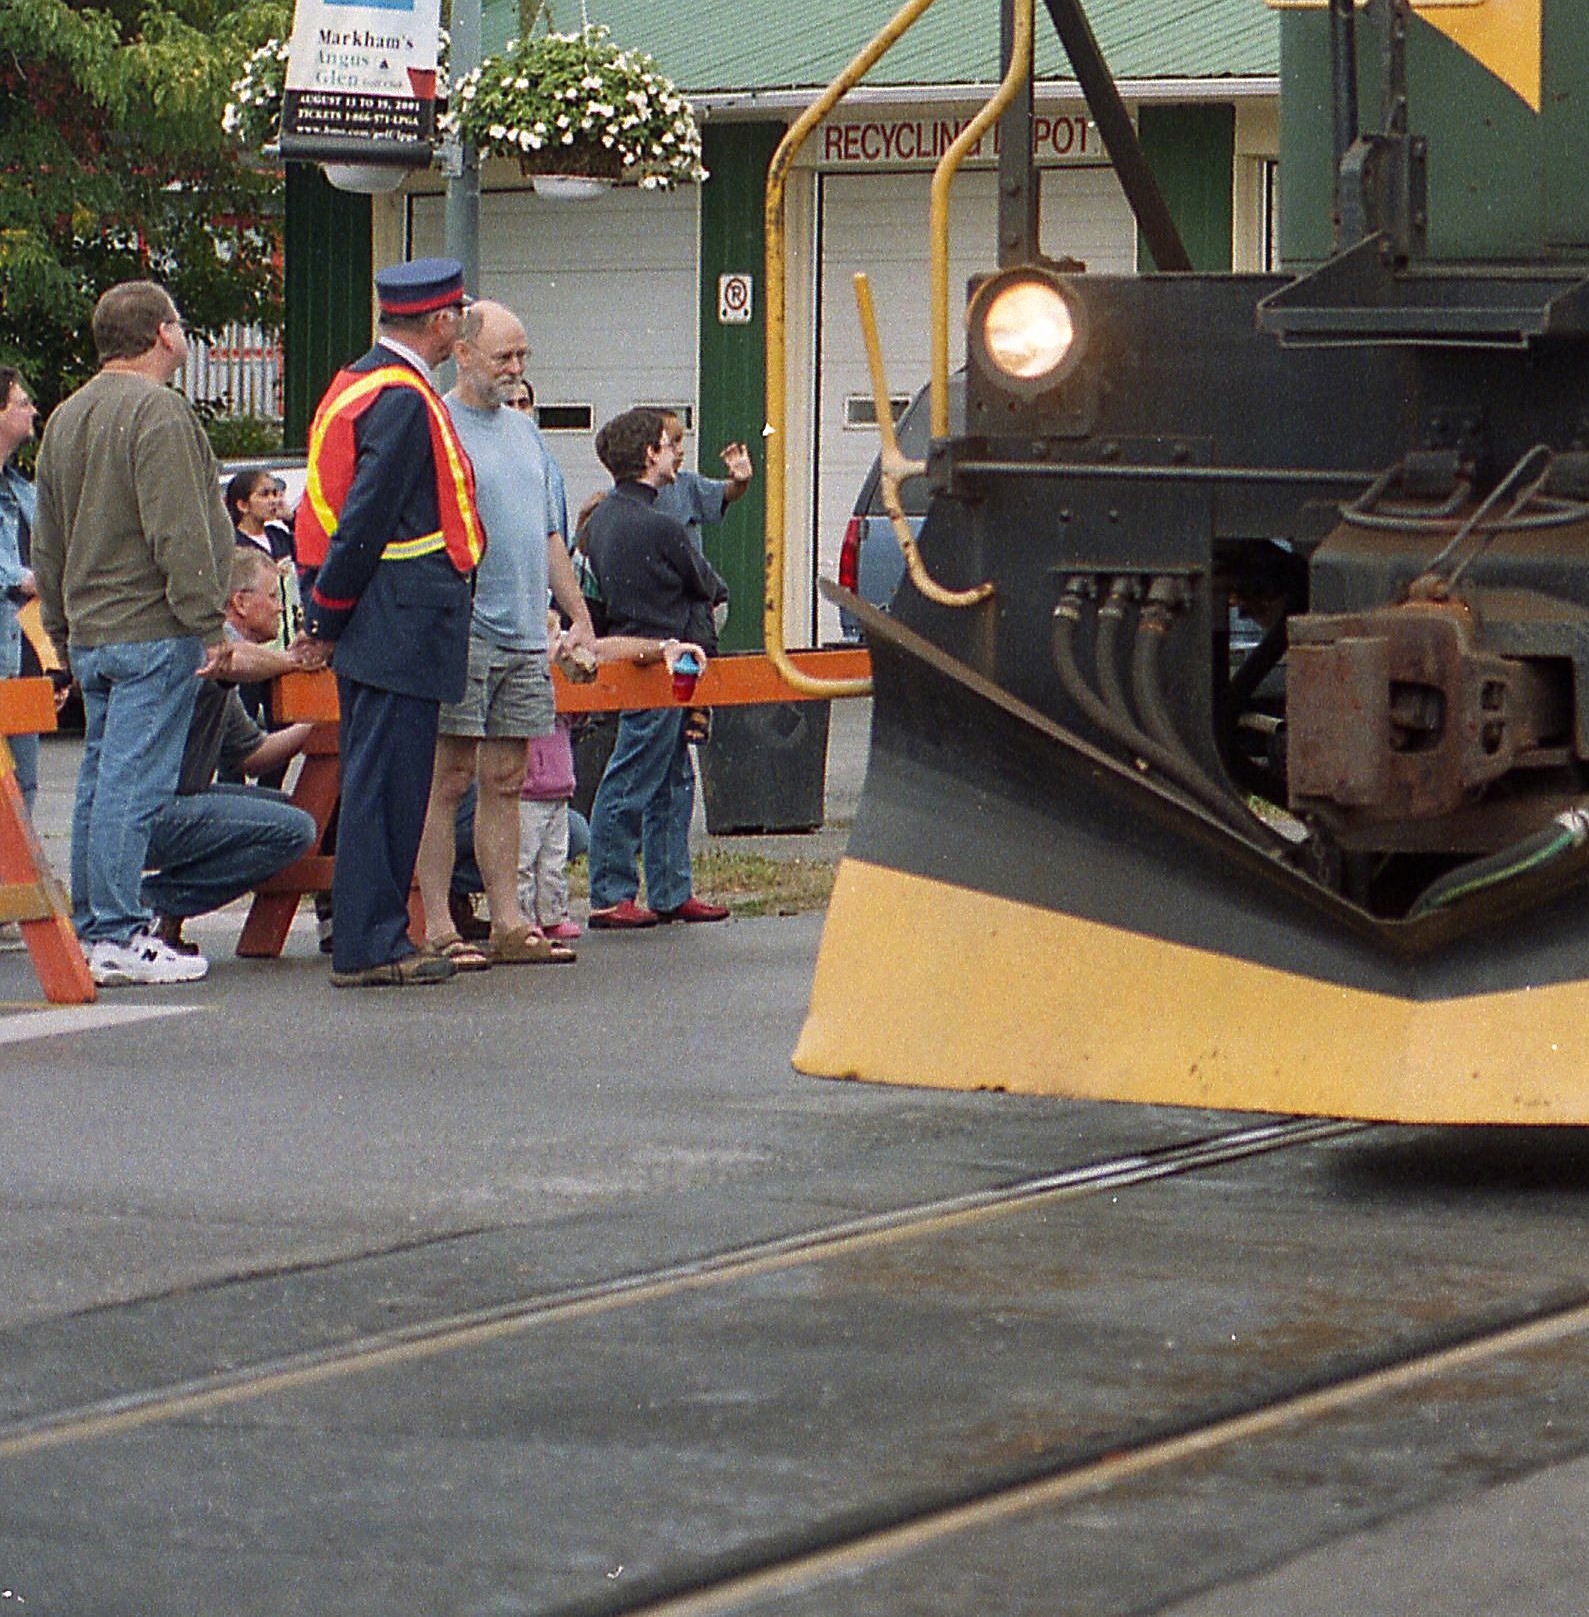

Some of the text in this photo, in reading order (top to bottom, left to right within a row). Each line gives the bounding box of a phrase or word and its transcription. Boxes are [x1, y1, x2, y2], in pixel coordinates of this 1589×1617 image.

[319, 29, 414, 51] Markham's
[316, 50, 370, 69] Angus
[315, 70, 359, 87] Glen
[299, 94, 341, 106] AUGUST
[360, 97, 374, 108] TO
[395, 100, 420, 112] 2001
[298, 108, 342, 120] TICKETS
